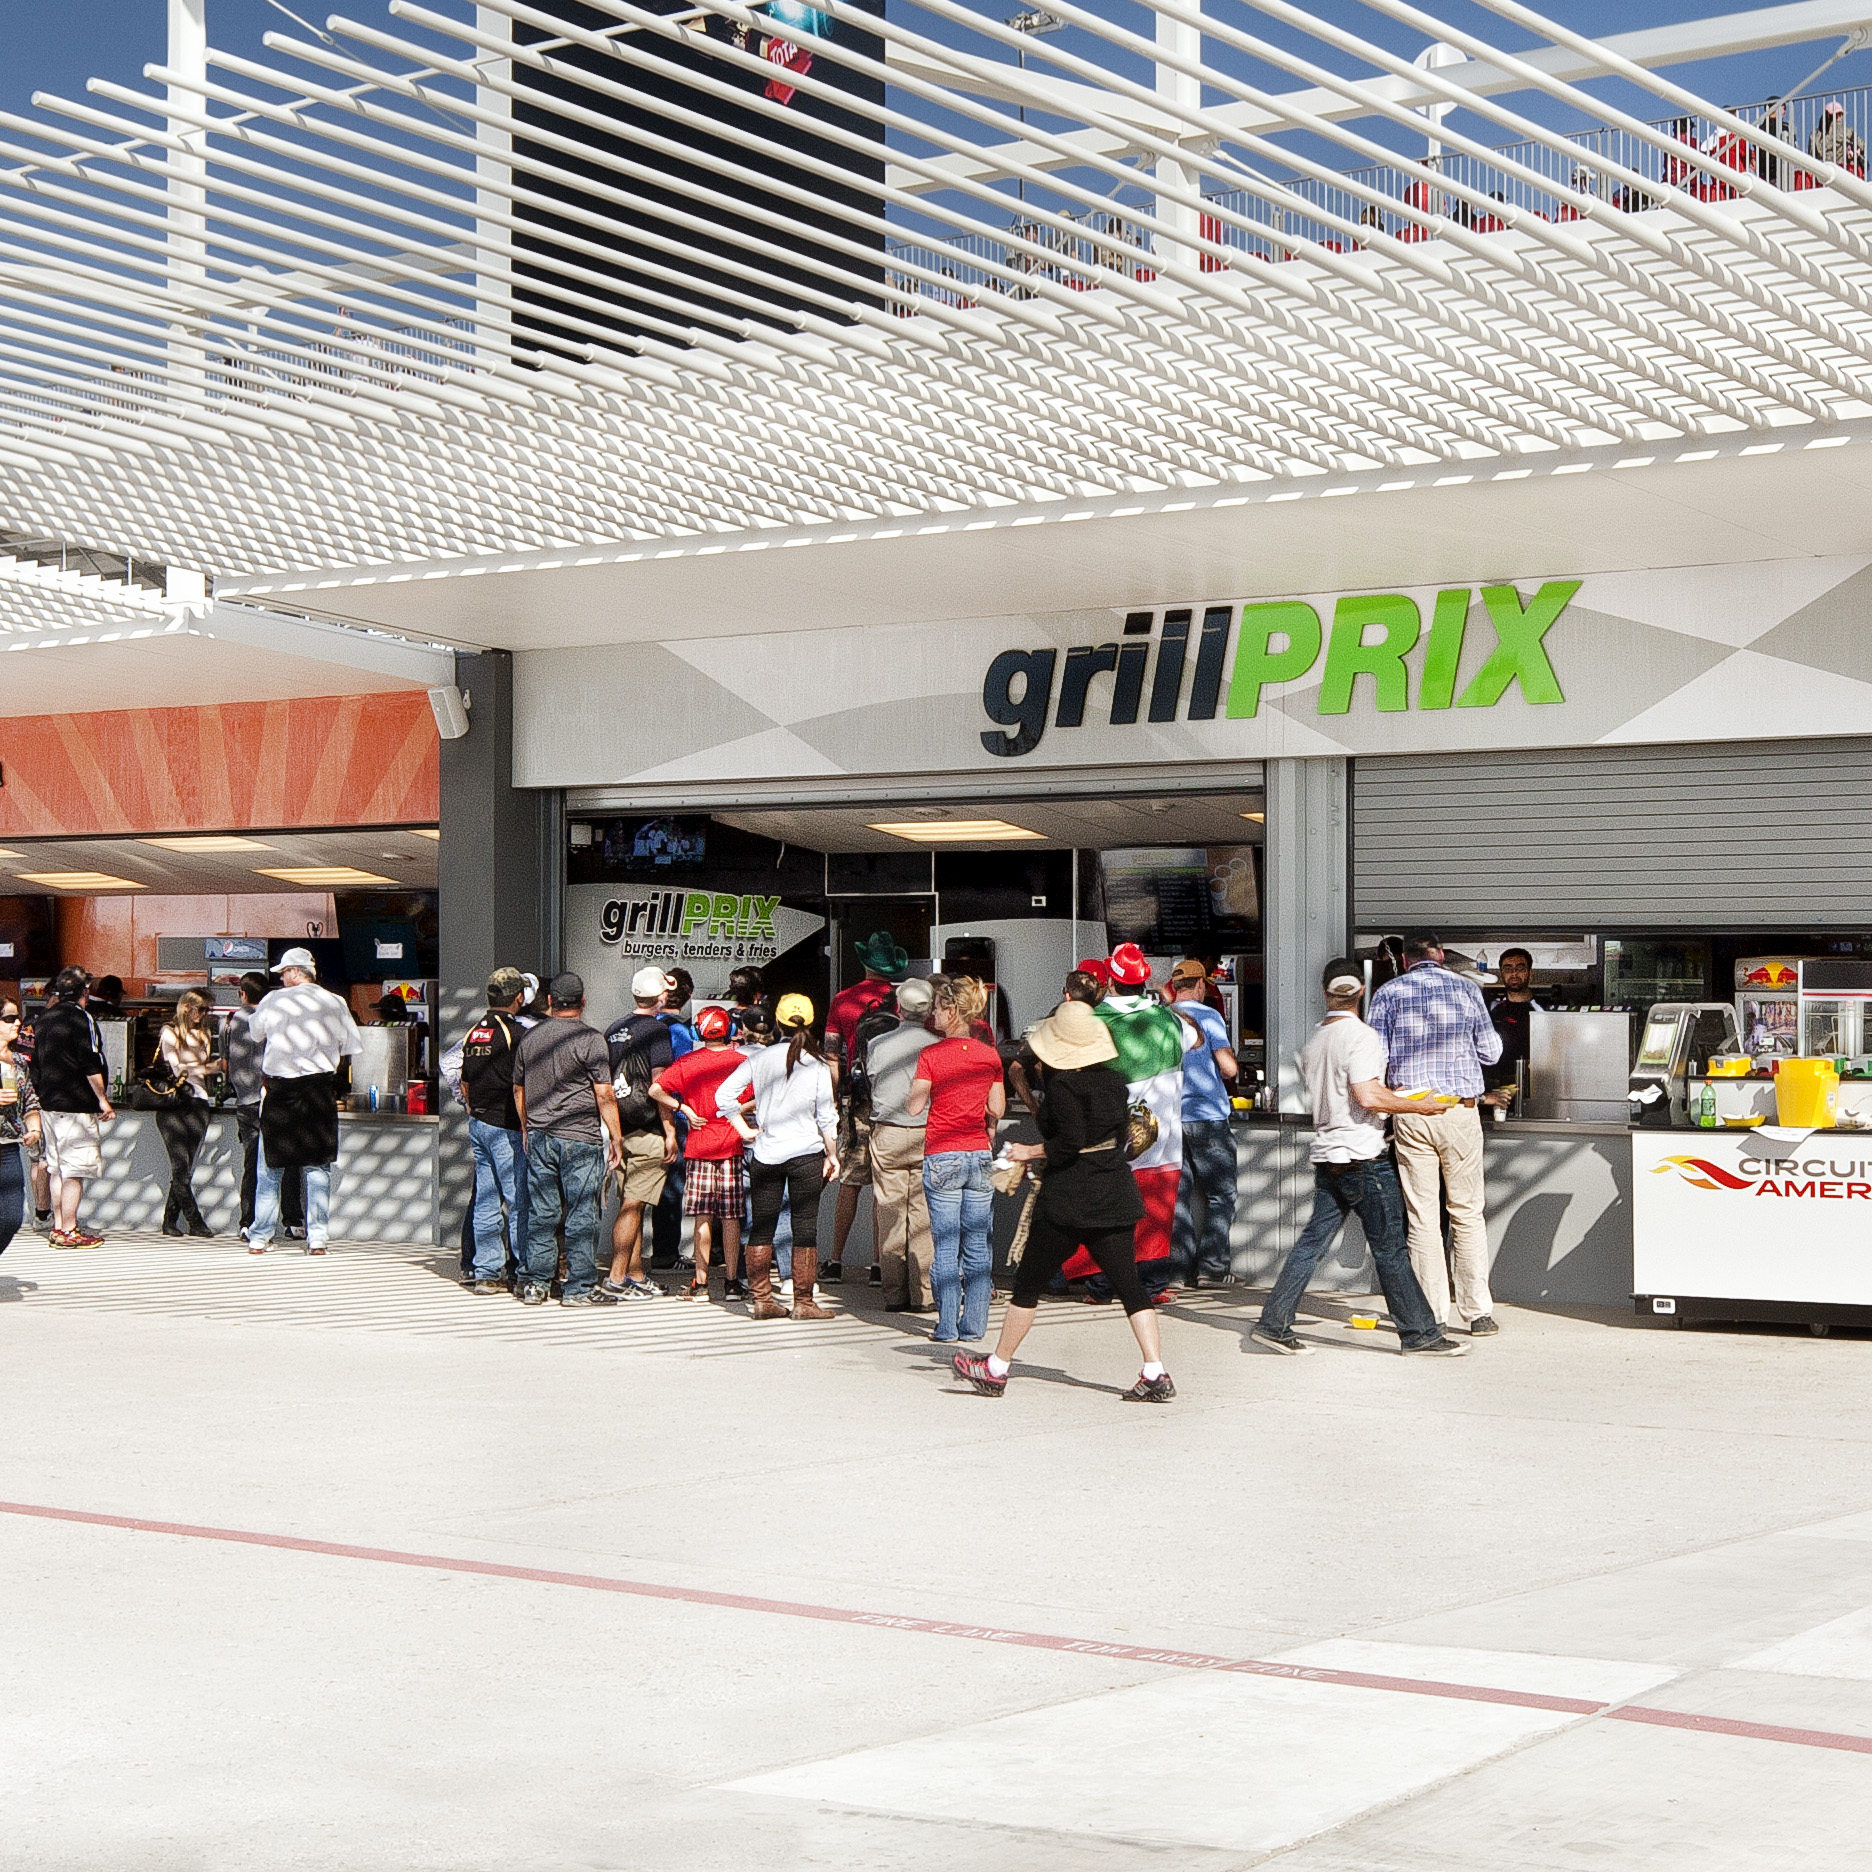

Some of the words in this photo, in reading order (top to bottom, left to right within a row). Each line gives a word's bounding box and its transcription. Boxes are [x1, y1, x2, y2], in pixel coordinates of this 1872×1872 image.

[980, 580, 1584, 757] grillPRIX
[600, 891, 781, 943] grillPRIX
[623, 941, 679, 959] burgers,
[683, 942, 732, 957] tenders
[736, 943, 744, 957] &
[748, 943, 777, 958] fries
